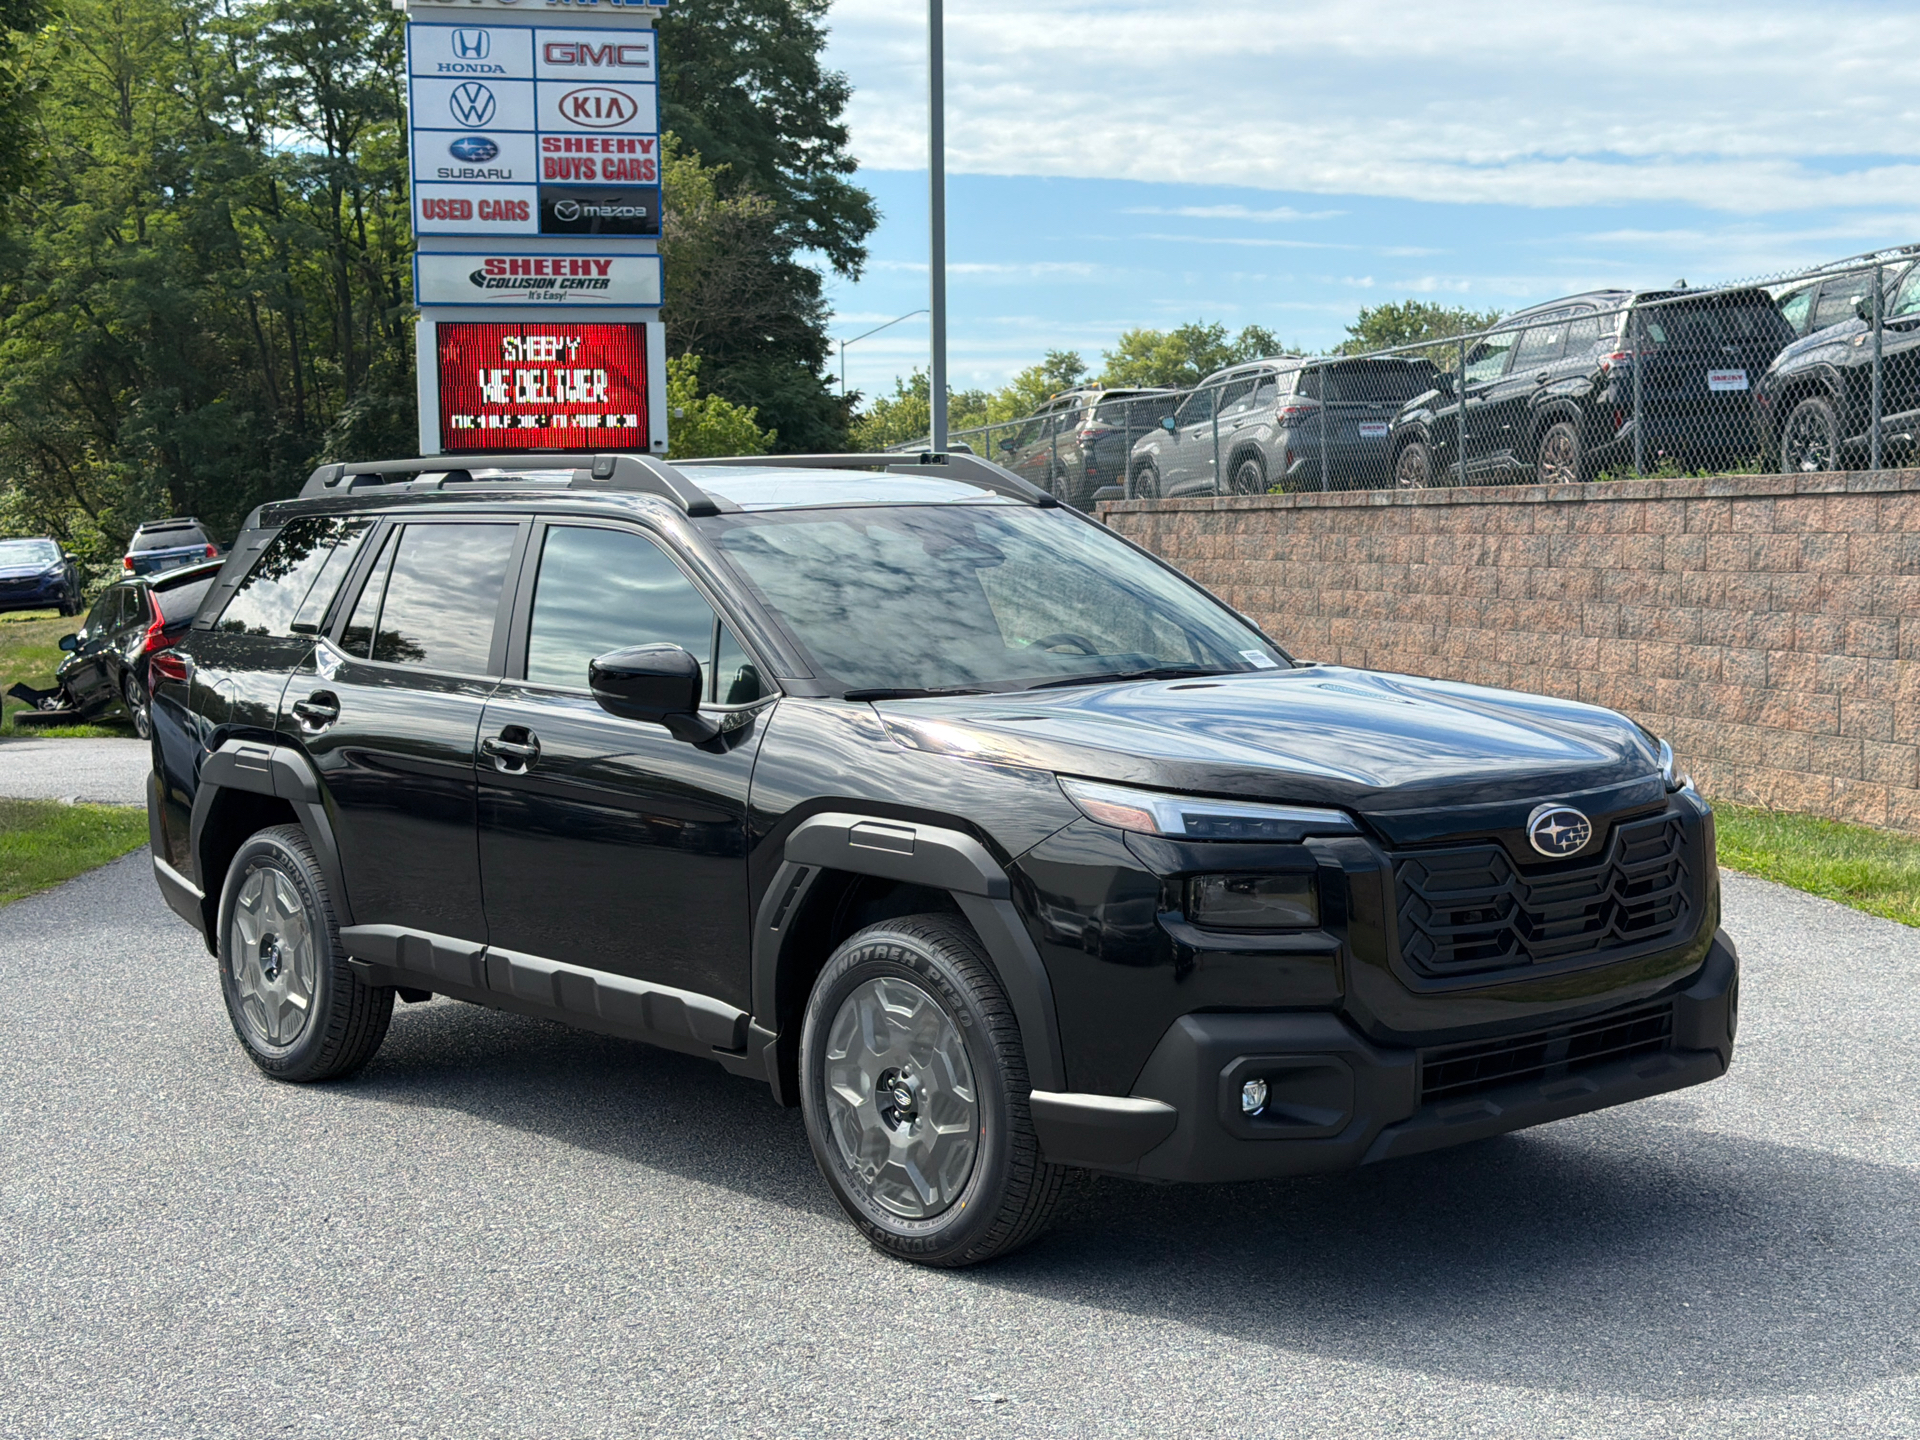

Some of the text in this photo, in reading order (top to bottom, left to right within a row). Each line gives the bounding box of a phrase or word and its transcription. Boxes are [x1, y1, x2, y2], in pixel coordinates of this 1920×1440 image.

[543, 42, 649, 68] GMC
[437, 63, 506, 74] HONDA
[572, 97, 625, 119] KIA
[542, 137, 655, 154] SHEEHY
[437, 167, 512, 180] SUBARU
[543, 157, 655, 182] BUYS CARS
[422, 198, 530, 222] USED CARS
[583, 205, 647, 217] mazda
[484, 258, 613, 276] SHEEHY
[485, 277, 611, 290] COLLISION CENTER
[528, 290, 567, 301] It's Easy!
[859, 1220, 939, 1253] DUNLOP
